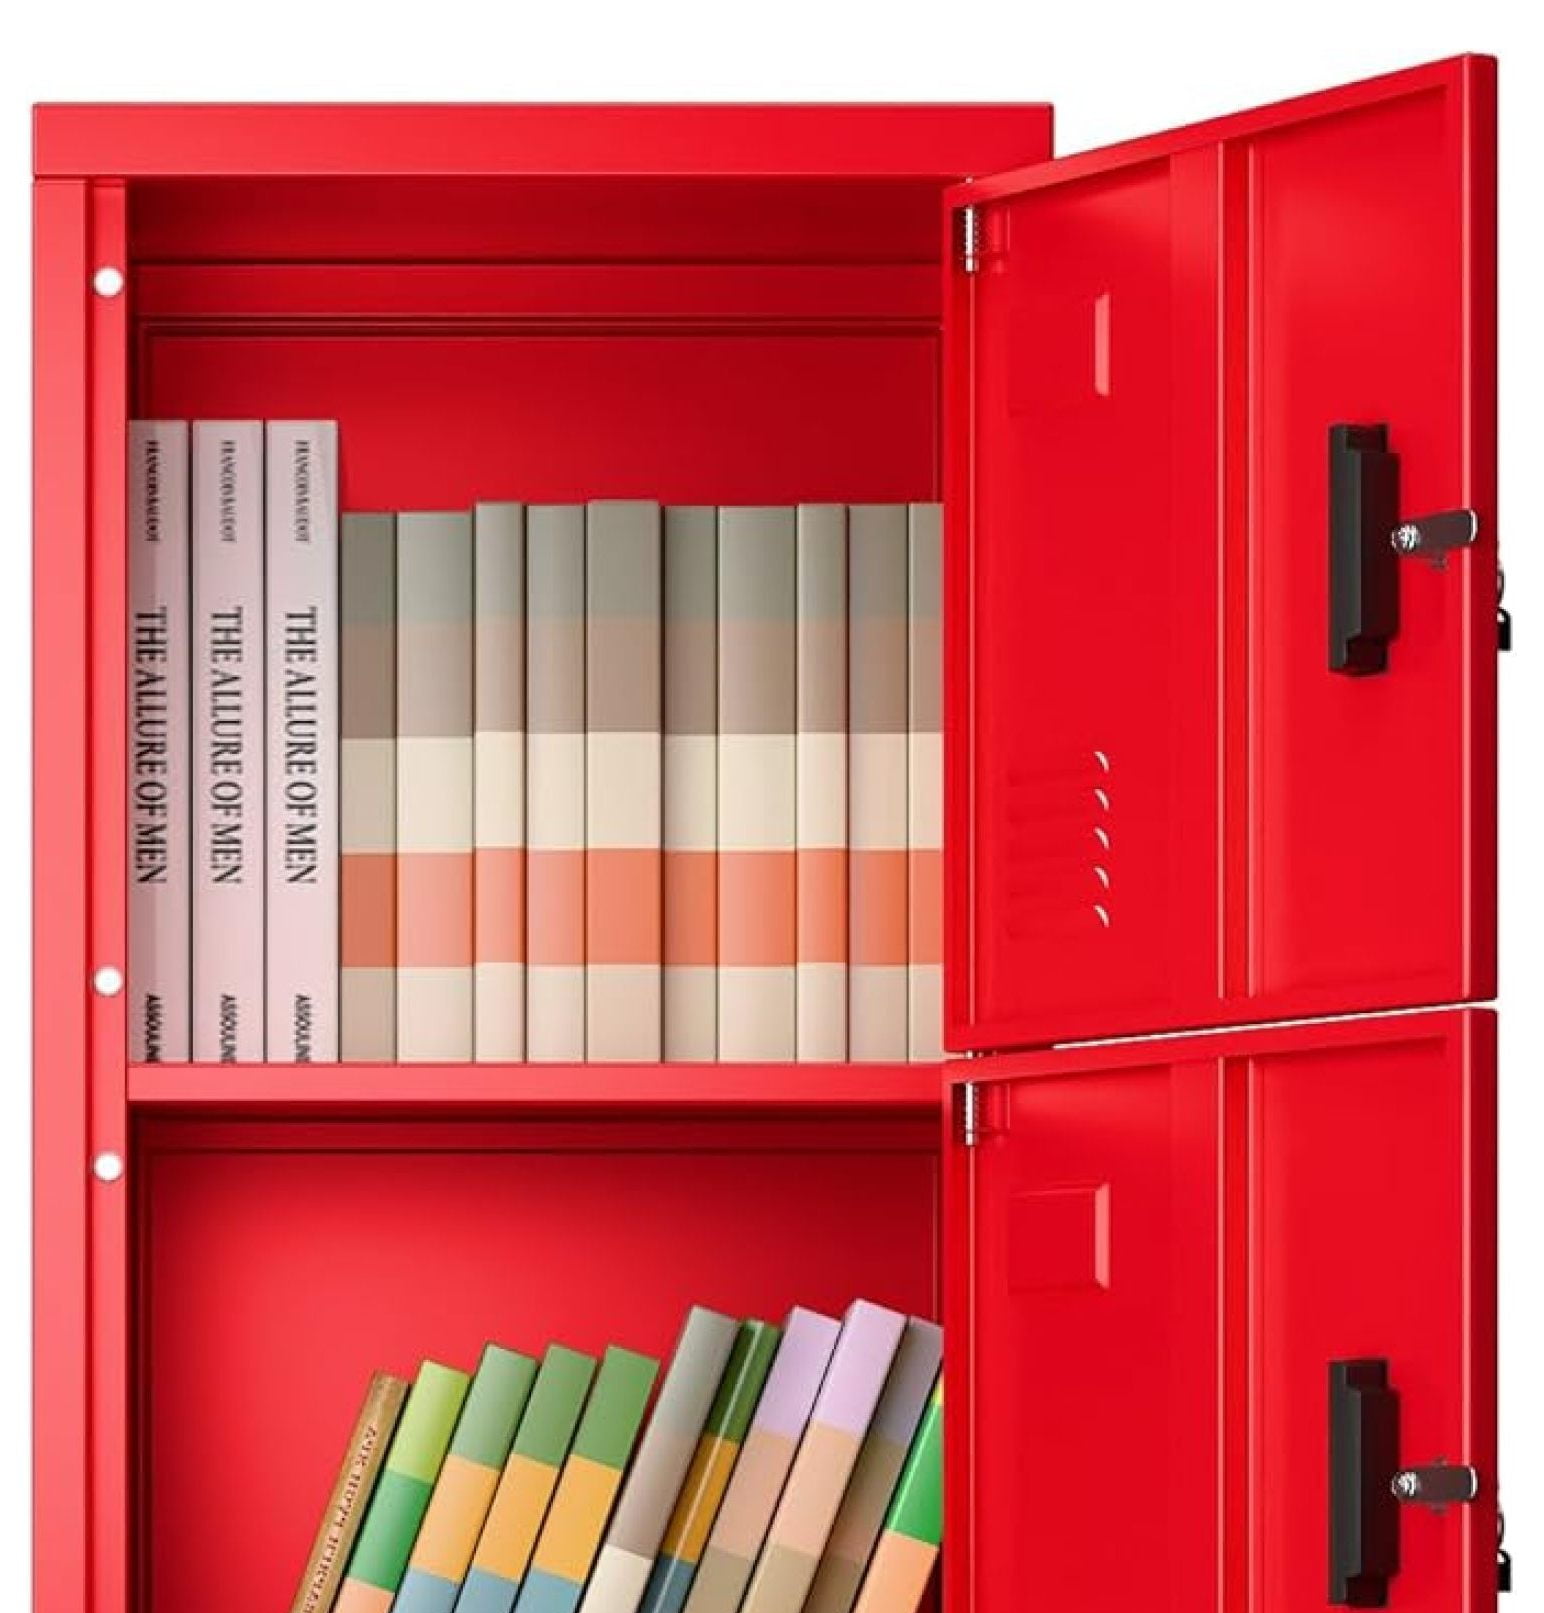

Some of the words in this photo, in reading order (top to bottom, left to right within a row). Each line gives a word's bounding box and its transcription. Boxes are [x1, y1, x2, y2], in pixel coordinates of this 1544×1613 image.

[135, 606, 167, 662] THE
[211, 606, 243, 662] THE
[285, 606, 317, 662] THE
[135, 669, 167, 774] ALLURE
[211, 669, 243, 774] ALLURE
[285, 669, 317, 774] ALLURE
[135, 781, 167, 817] OF
[211, 781, 243, 817] OF
[285, 781, 317, 817] OF
[135, 824, 167, 884] MEN
[211, 824, 243, 884] MEN
[285, 824, 317, 884] MEN
